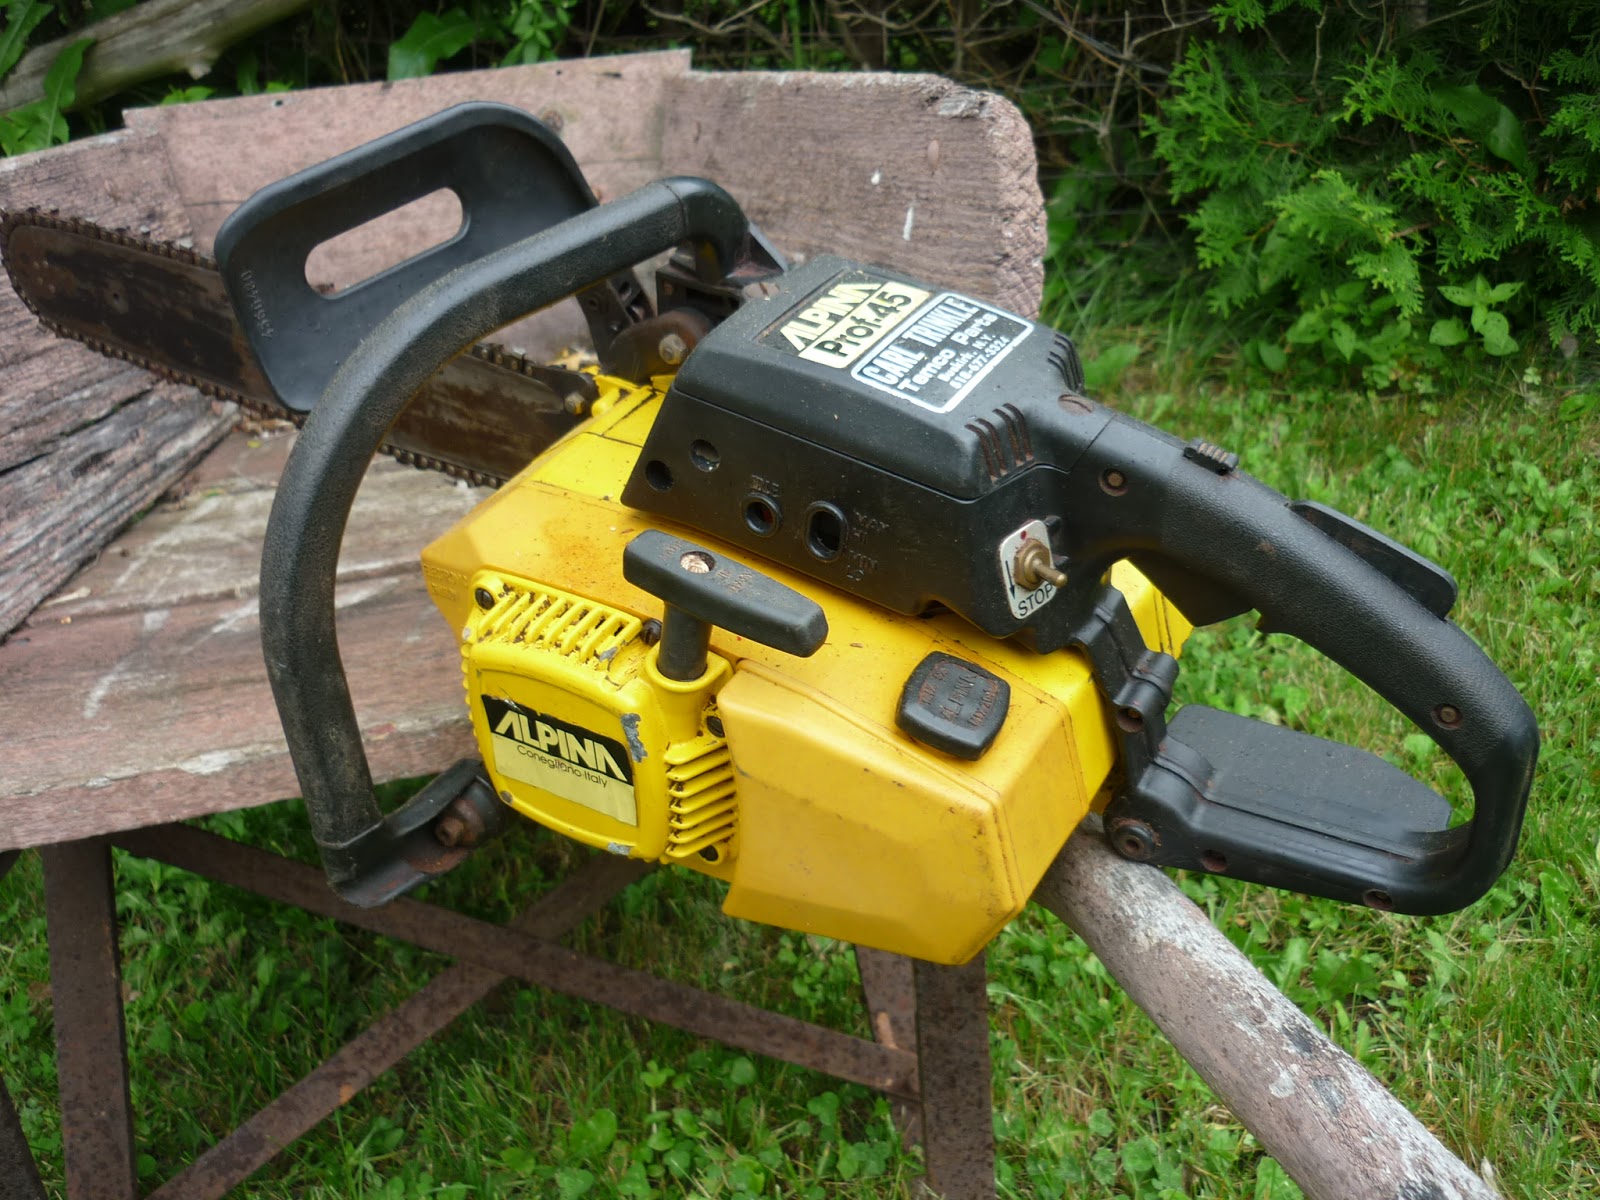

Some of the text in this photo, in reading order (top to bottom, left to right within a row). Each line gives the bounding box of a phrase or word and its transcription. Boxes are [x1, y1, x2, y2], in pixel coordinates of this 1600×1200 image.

[780, 283, 882, 351] ALPINA
[861, 297, 979, 386] CARL TRINKLE
[951, 312, 998, 347] Parts
[1018, 583, 1054, 617] STOP
[495, 710, 628, 782] ALPINA
[517, 744, 582, 778] Conegliano
